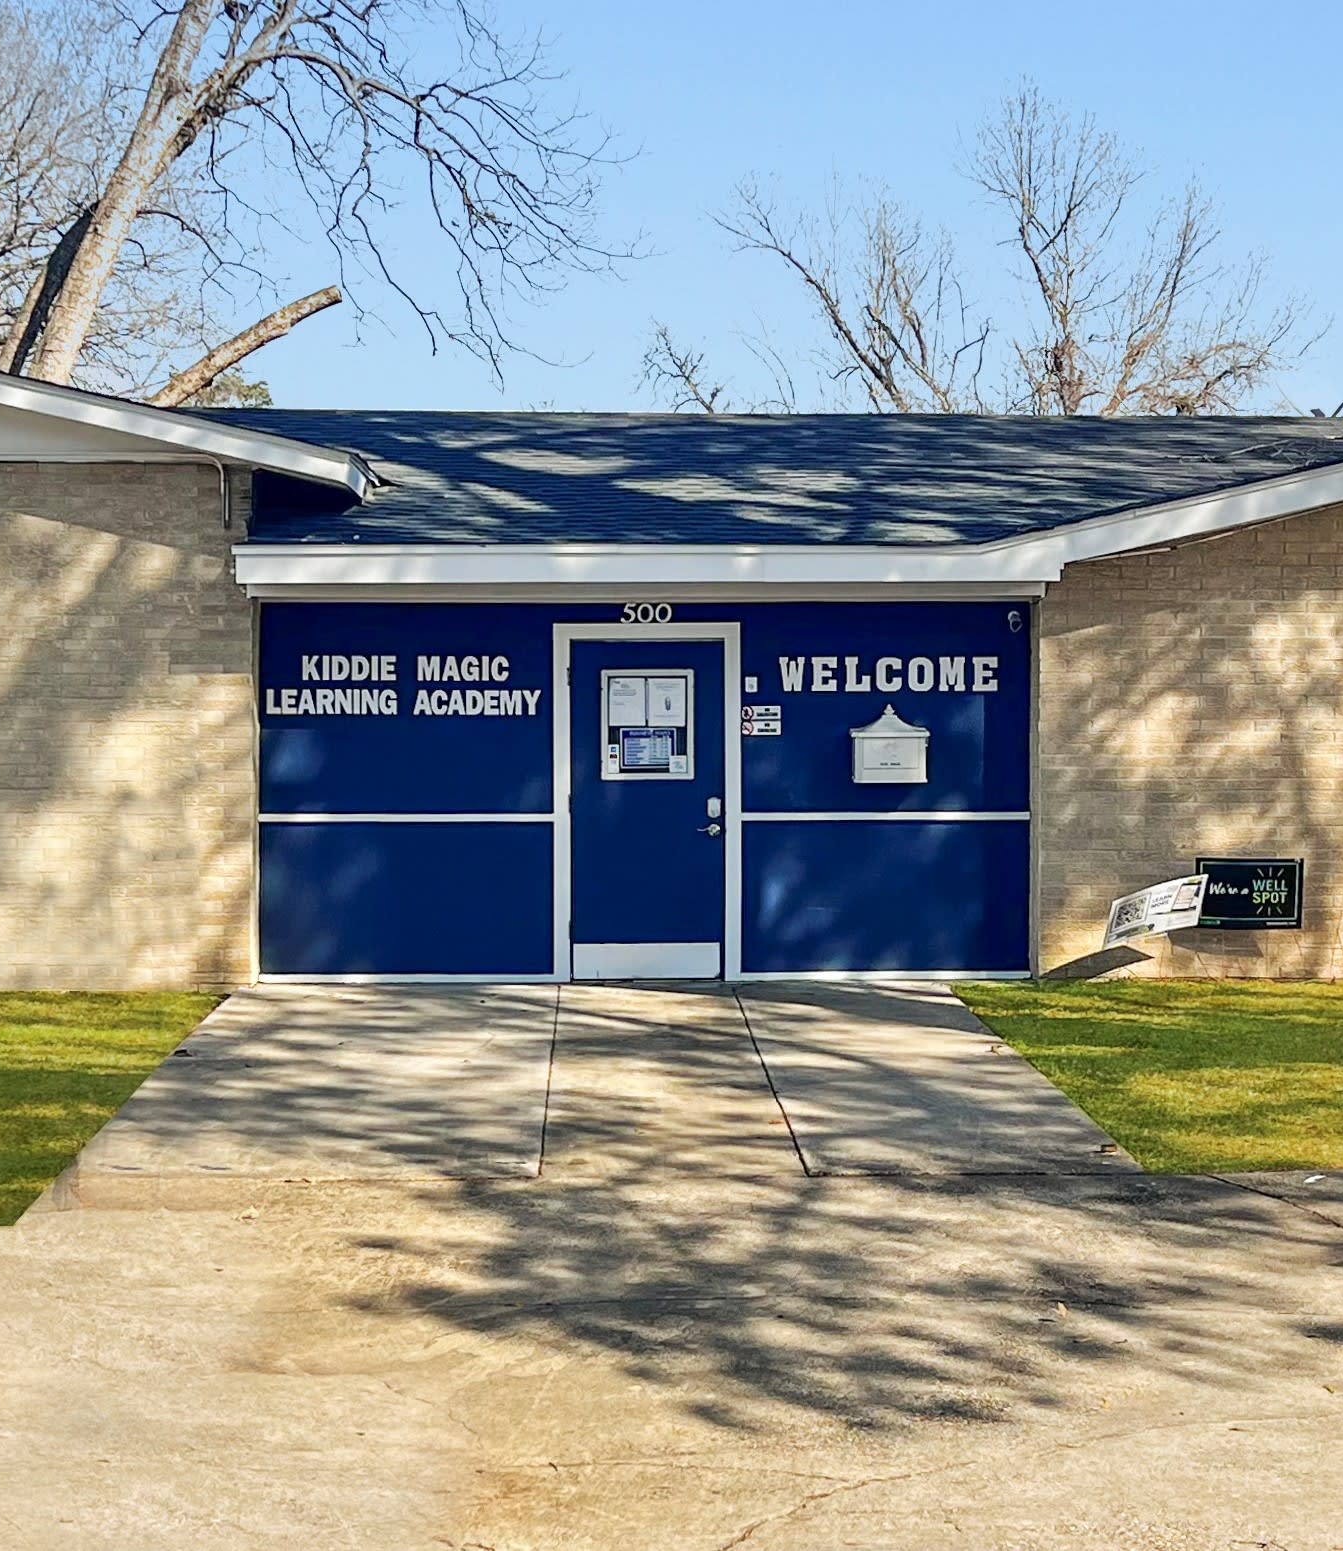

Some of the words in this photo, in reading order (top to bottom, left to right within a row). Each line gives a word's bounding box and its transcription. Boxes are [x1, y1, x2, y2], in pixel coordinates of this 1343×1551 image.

[620, 602, 672, 623] 500
[301, 655, 397, 681] KIDDIE
[417, 655, 510, 682] MAGIC
[778, 656, 999, 693] WELCOME
[265, 688, 398, 715] LEARNING
[413, 689, 542, 716] ACADEMY
[1252, 879, 1288, 892] WELL
[1252, 891, 1288, 904] SPOT
